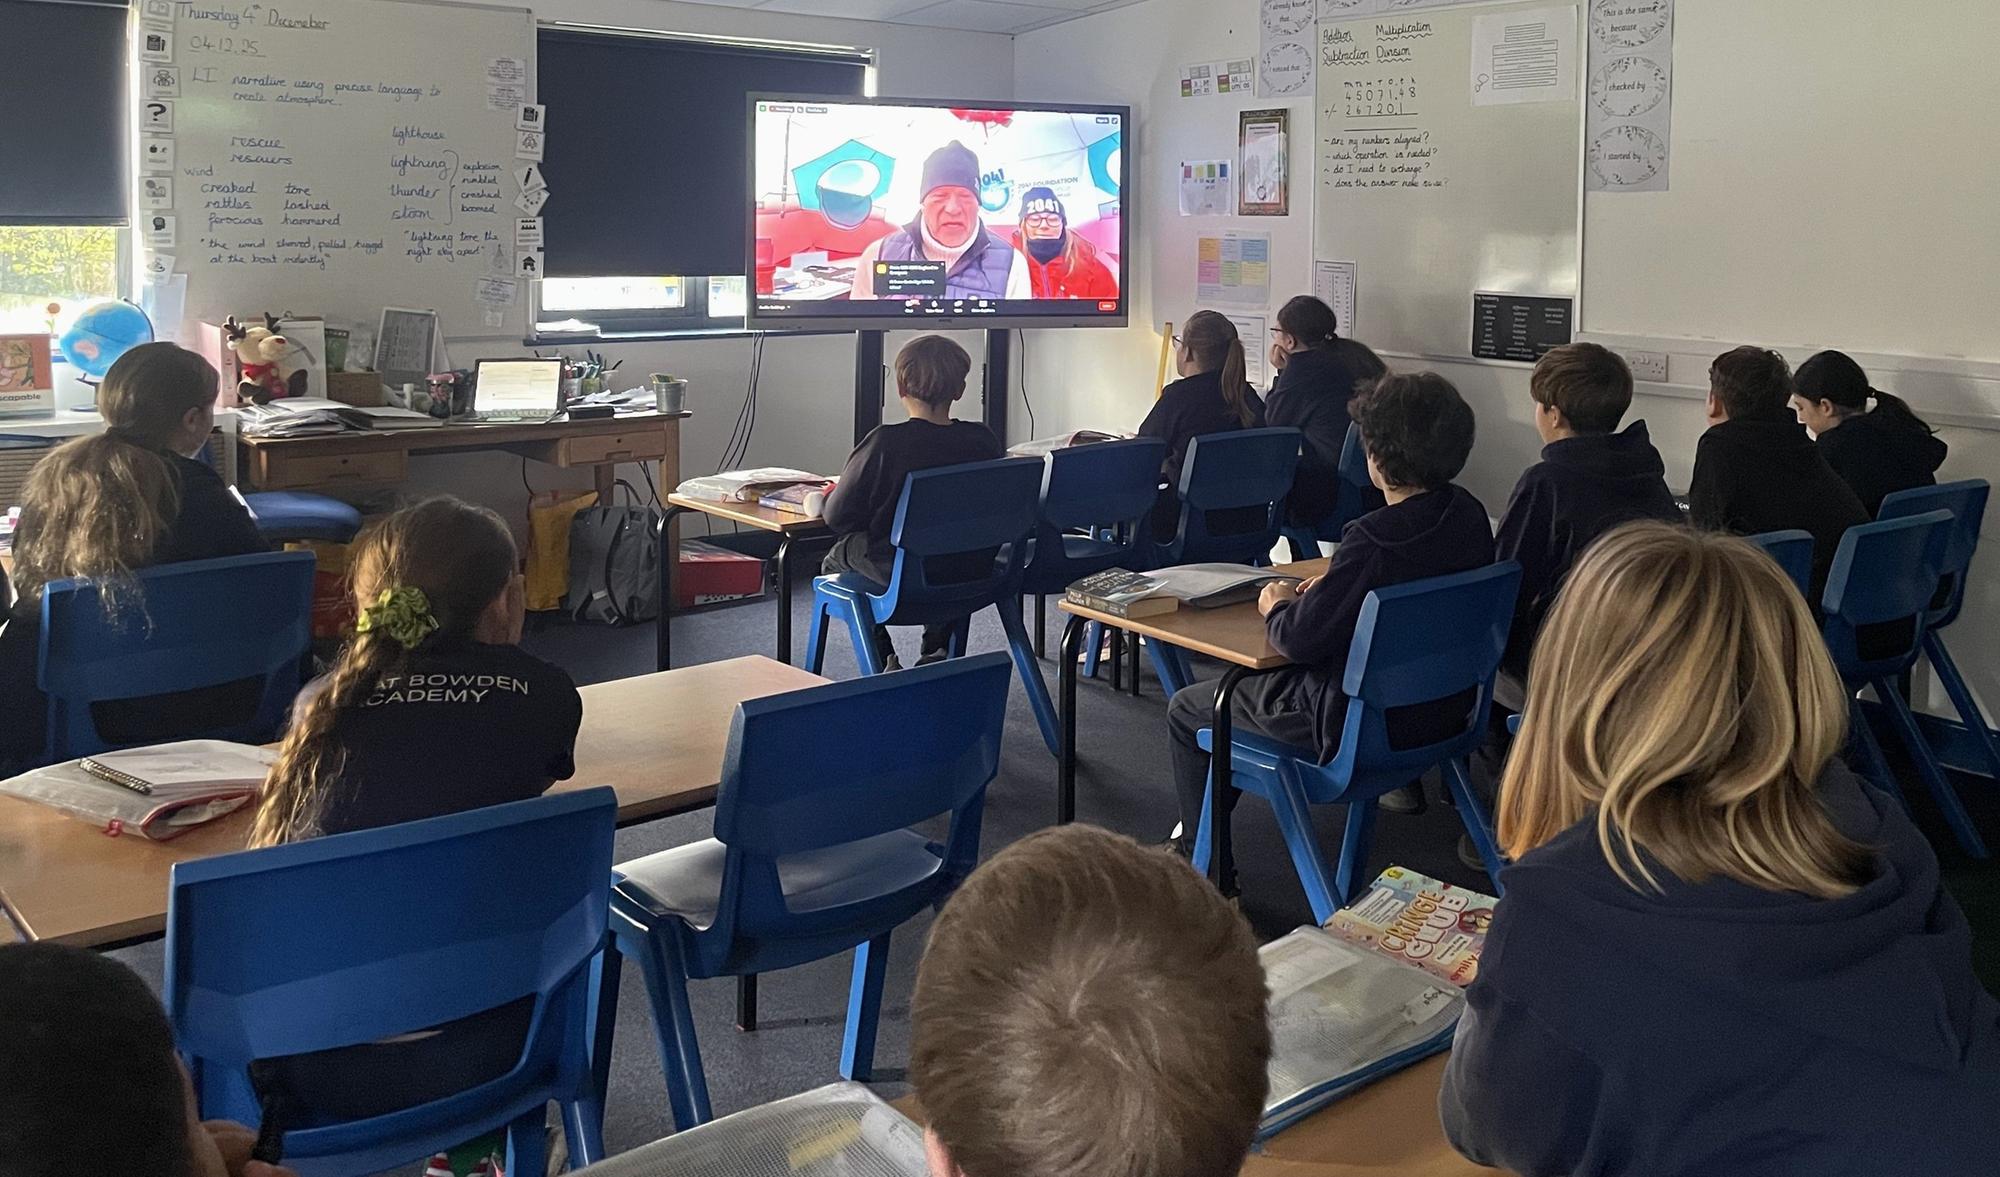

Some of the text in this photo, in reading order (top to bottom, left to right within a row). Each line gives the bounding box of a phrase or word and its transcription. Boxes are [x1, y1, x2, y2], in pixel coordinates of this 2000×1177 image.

[176, 2, 240, 30] Thursday
[1604, 8, 1616, 16] This
[1625, 6, 1636, 14] the
[1376, 21, 1432, 37] Multiplication
[1610, 23, 1637, 32] because
[1322, 45, 1411, 61] Subtraction Division
[232, 75, 287, 87] narrative
[294, 80, 324, 97] using
[377, 82, 423, 102] language
[429, 84, 441, 96] to
[1609, 81, 1635, 91] checked
[1636, 80, 1646, 93] by
[233, 92, 264, 101] create
[231, 137, 285, 149] rescue
[392, 126, 446, 146] lighthouse
[1348, 138, 1358, 153] my
[1361, 134, 1390, 145] numbers
[229, 154, 293, 165] rescuers
[1332, 151, 1352, 160] which
[1355, 148, 1388, 163] operation
[1608, 151, 1631, 160] started
[1633, 152, 1641, 163] by
[184, 165, 213, 177] wind
[391, 155, 451, 180] lightning
[1333, 165, 1344, 174] do
[1346, 163, 1354, 173] I
[1358, 163, 1374, 173] need
[1379, 163, 1386, 173] to
[201, 181, 311, 196] creaked tore
[1033, 177, 1079, 187] FOUNDATION
[1356, 179, 1368, 187] the
[1371, 180, 1399, 188] answer
[391, 184, 441, 198] thunder
[461, 189, 502, 199] crashed
[204, 197, 330, 211] rattles lashed
[461, 204, 497, 214] boomed
[1027, 199, 1060, 213] 2041
[391, 205, 434, 220] storm
[208, 212, 341, 231] ferocious hammered
[460, 231, 480, 242] tore
[484, 230, 500, 241] the
[238, 238, 265, 249] wind
[353, 240, 384, 254] tugged
[210, 255, 222, 264] at
[228, 254, 246, 264] the
[251, 254, 277, 264] boat
[406, 247, 433, 263] night
[437, 246, 454, 263] sky
[409, 674, 528, 695] BOWDEN
[360, 689, 489, 707] CADEMY
[1405, 894, 1470, 959] CLUB
